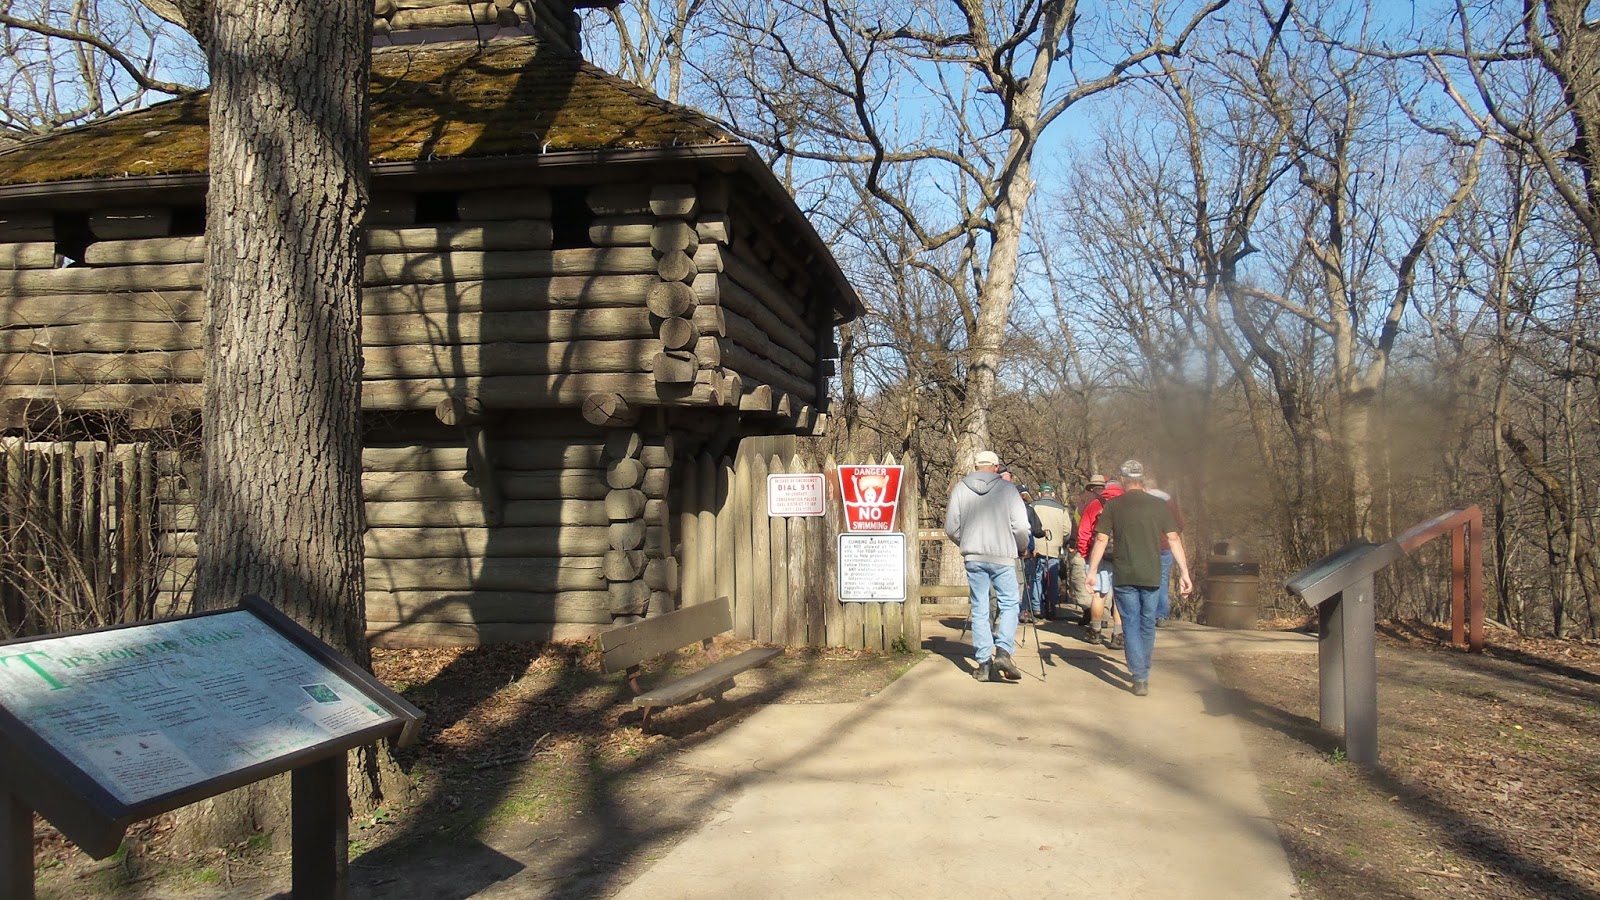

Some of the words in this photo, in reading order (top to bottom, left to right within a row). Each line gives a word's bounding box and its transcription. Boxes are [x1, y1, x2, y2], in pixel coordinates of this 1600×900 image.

[854, 468, 887, 476] DANGER
[859, 507, 882, 520] NO
[853, 521, 888, 530] SWIMMING
[98, 647, 142, 663] FOR
